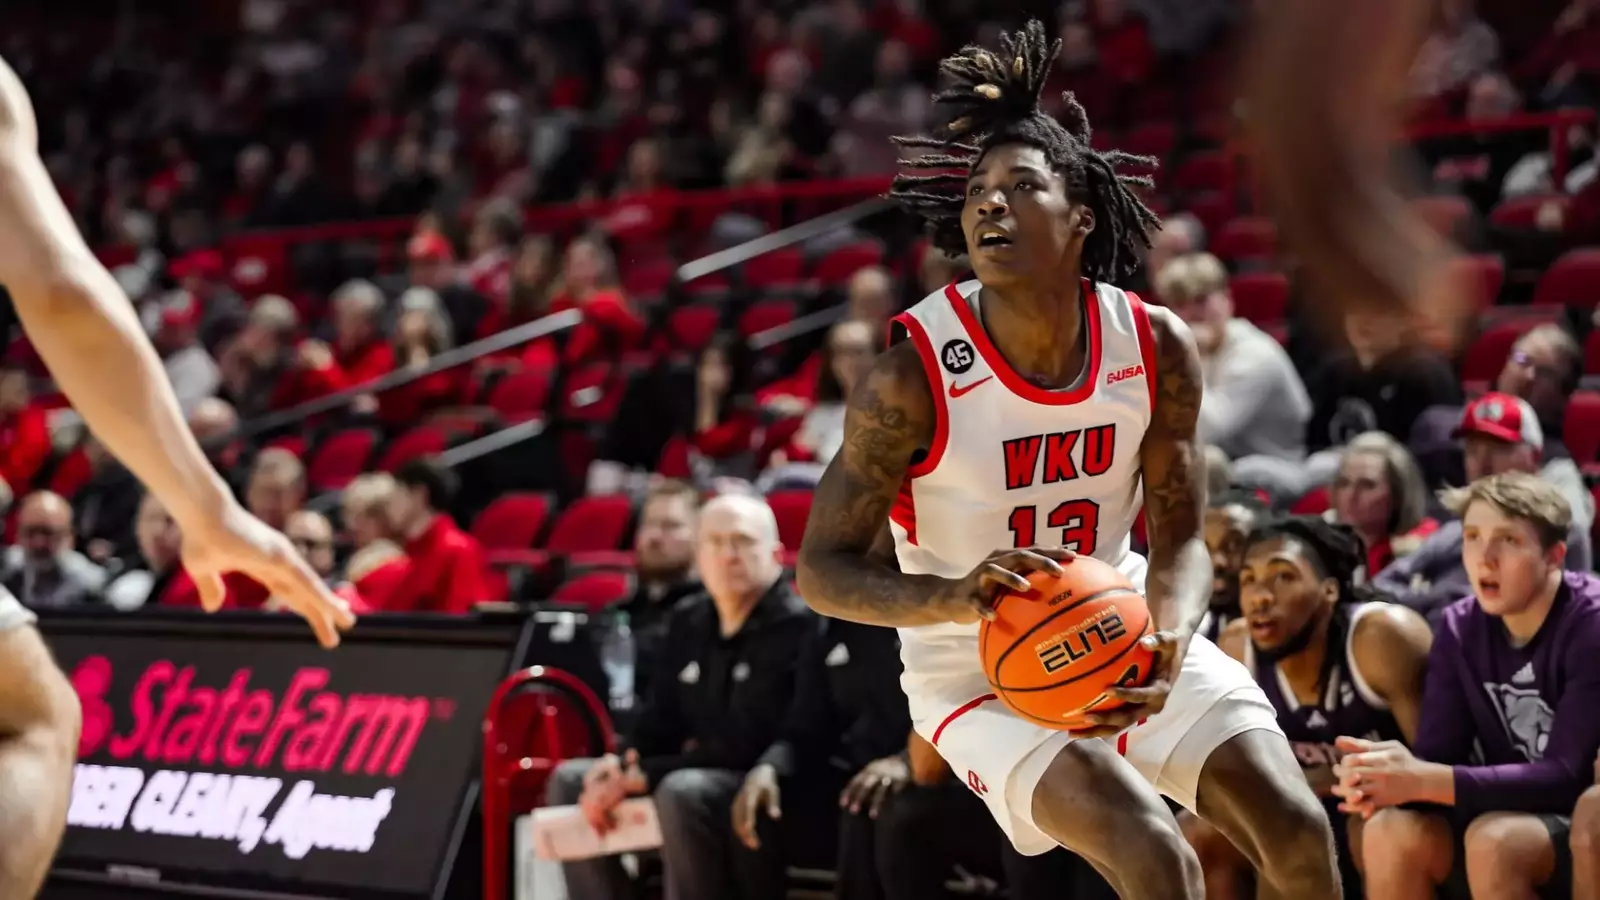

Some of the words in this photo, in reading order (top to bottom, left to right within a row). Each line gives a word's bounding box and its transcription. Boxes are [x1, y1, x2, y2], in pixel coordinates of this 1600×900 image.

[945, 342, 974, 369] 45
[1002, 423, 1116, 490] WKU
[1008, 499, 1100, 557] 13
[1038, 613, 1127, 674] ELITE
